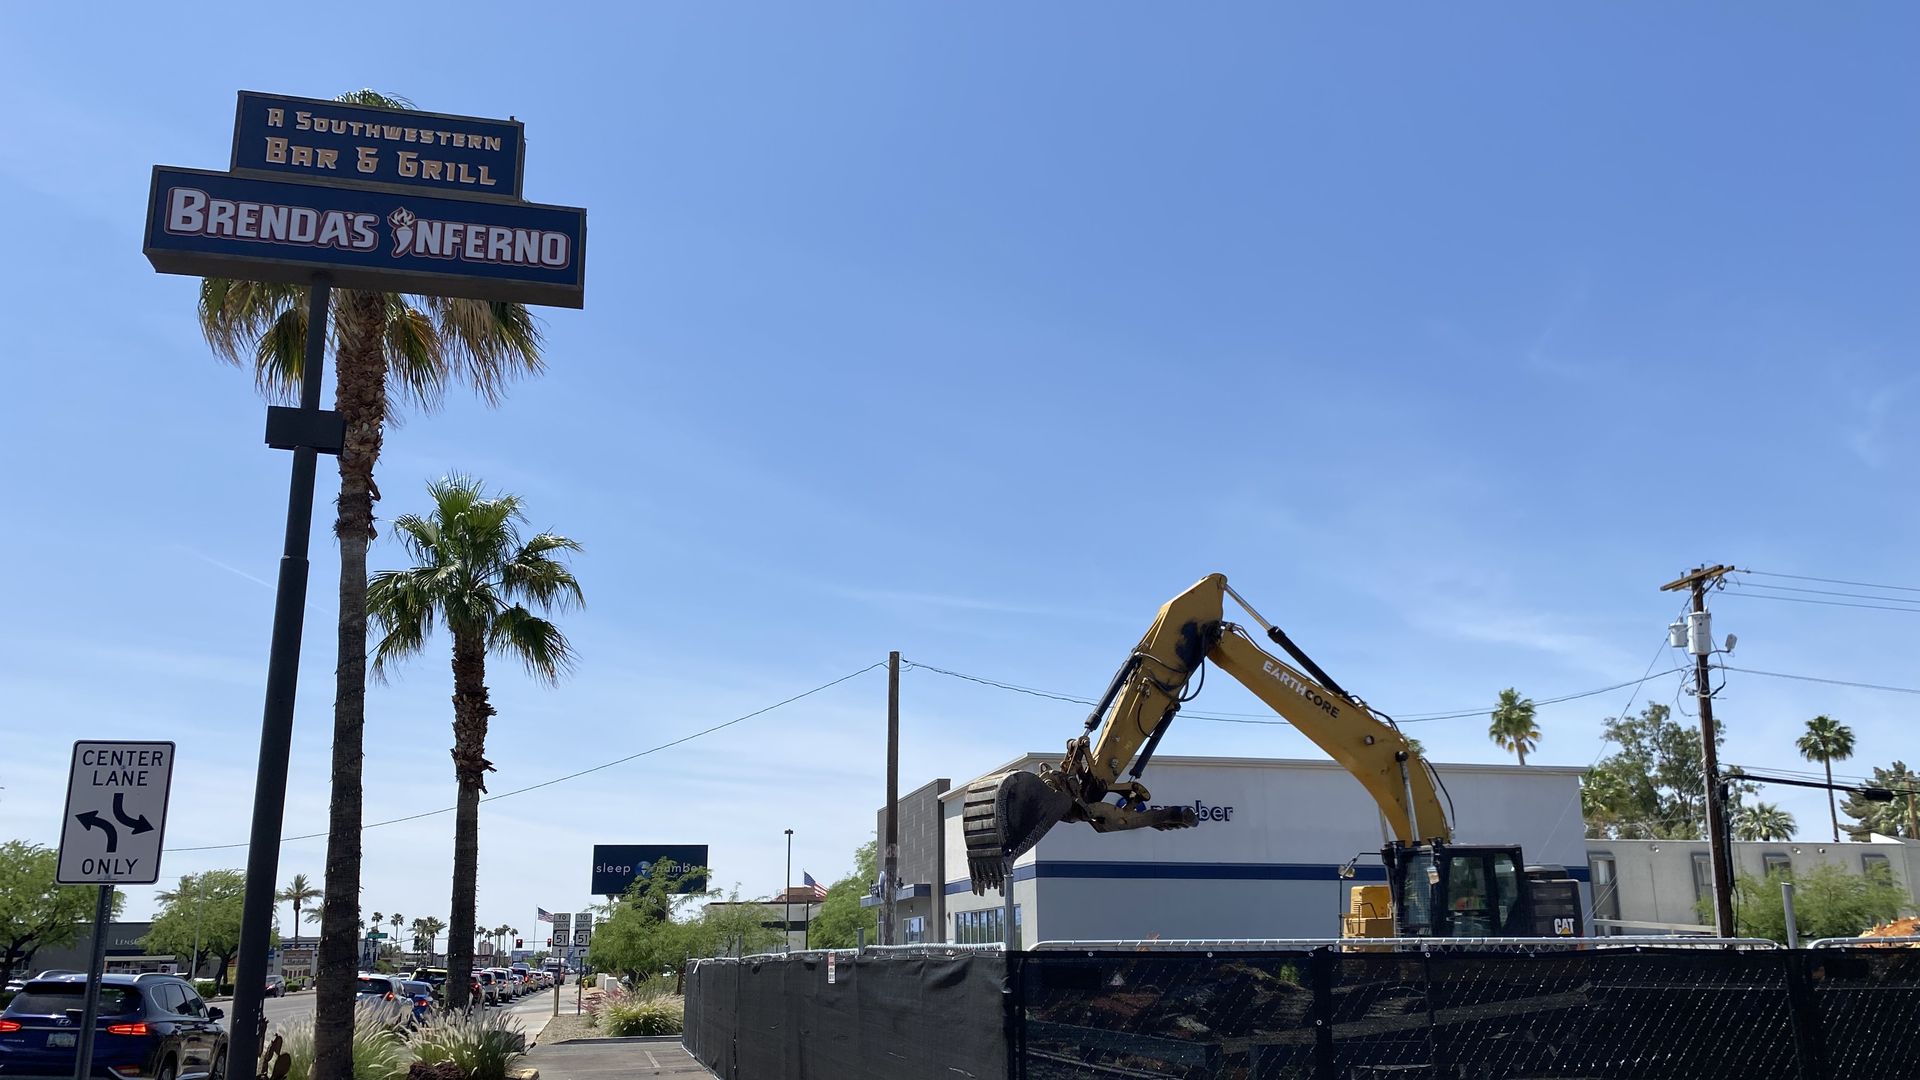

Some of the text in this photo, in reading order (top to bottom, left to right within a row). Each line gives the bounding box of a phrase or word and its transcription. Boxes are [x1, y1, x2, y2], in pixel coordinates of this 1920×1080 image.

[267, 108, 501, 151] A SOUTHWESTERN
[265, 137, 497, 186] BAR & GRILL
[167, 188, 376, 249] BRENDA'S
[1262, 660, 1340, 719] EARTHCORE
[82, 750, 164, 766] CENTER
[92, 770, 149, 786] LANE
[81, 858, 139, 875] ONLY
[596, 862, 631, 877] sleep
[1554, 918, 1574, 935] CAT
[556, 934, 567, 944] 51
[578, 934, 588, 944] 51
